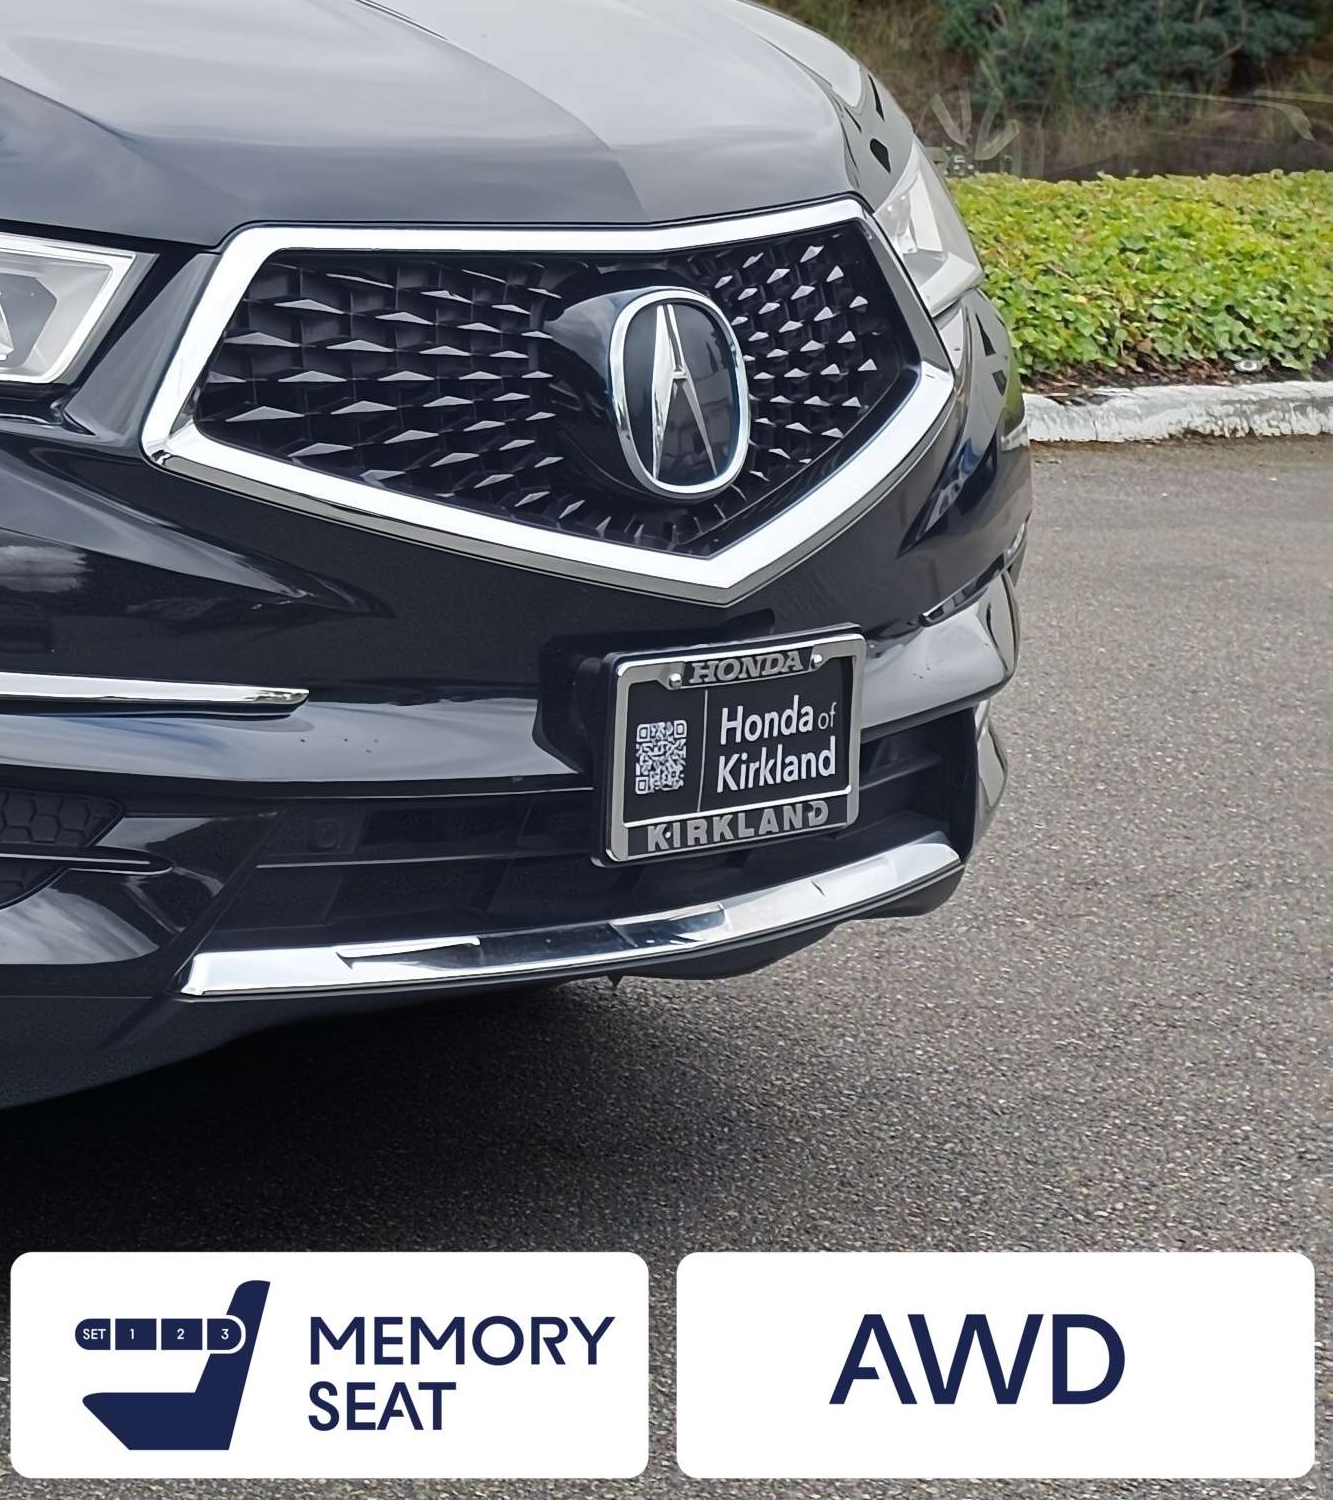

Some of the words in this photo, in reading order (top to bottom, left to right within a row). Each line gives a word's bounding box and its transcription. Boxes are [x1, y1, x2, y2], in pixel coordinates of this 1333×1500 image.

[688, 650, 805, 685] HONDA
[720, 694, 814, 745] Honda
[817, 701, 838, 730] of
[716, 735, 837, 794] Kirkland
[646, 800, 830, 852] KIRKLAND
